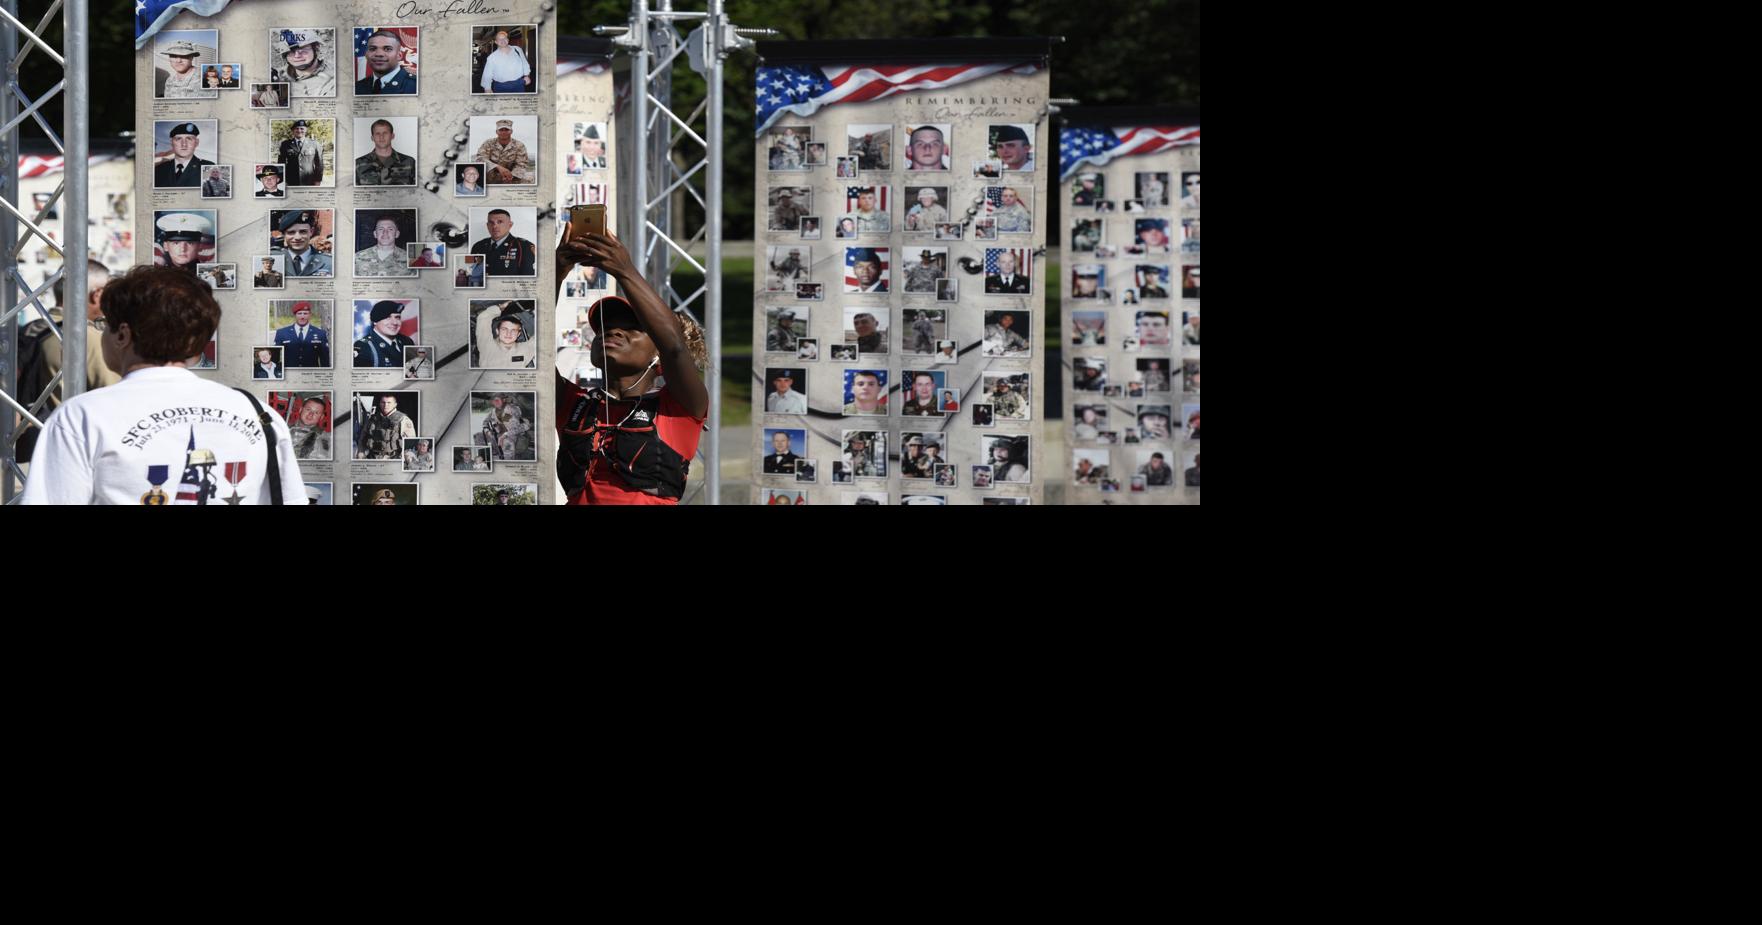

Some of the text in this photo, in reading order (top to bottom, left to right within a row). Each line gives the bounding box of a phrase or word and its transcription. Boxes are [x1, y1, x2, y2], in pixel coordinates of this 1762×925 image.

[396, 1, 432, 19] Our
[439, 0, 500, 18] Fallen
[280, 33, 306, 42] DRKS
[905, 96, 1036, 105] REMEMBERING
[121, 419, 151, 447] SFC
[150, 407, 228, 423] ROBERT
